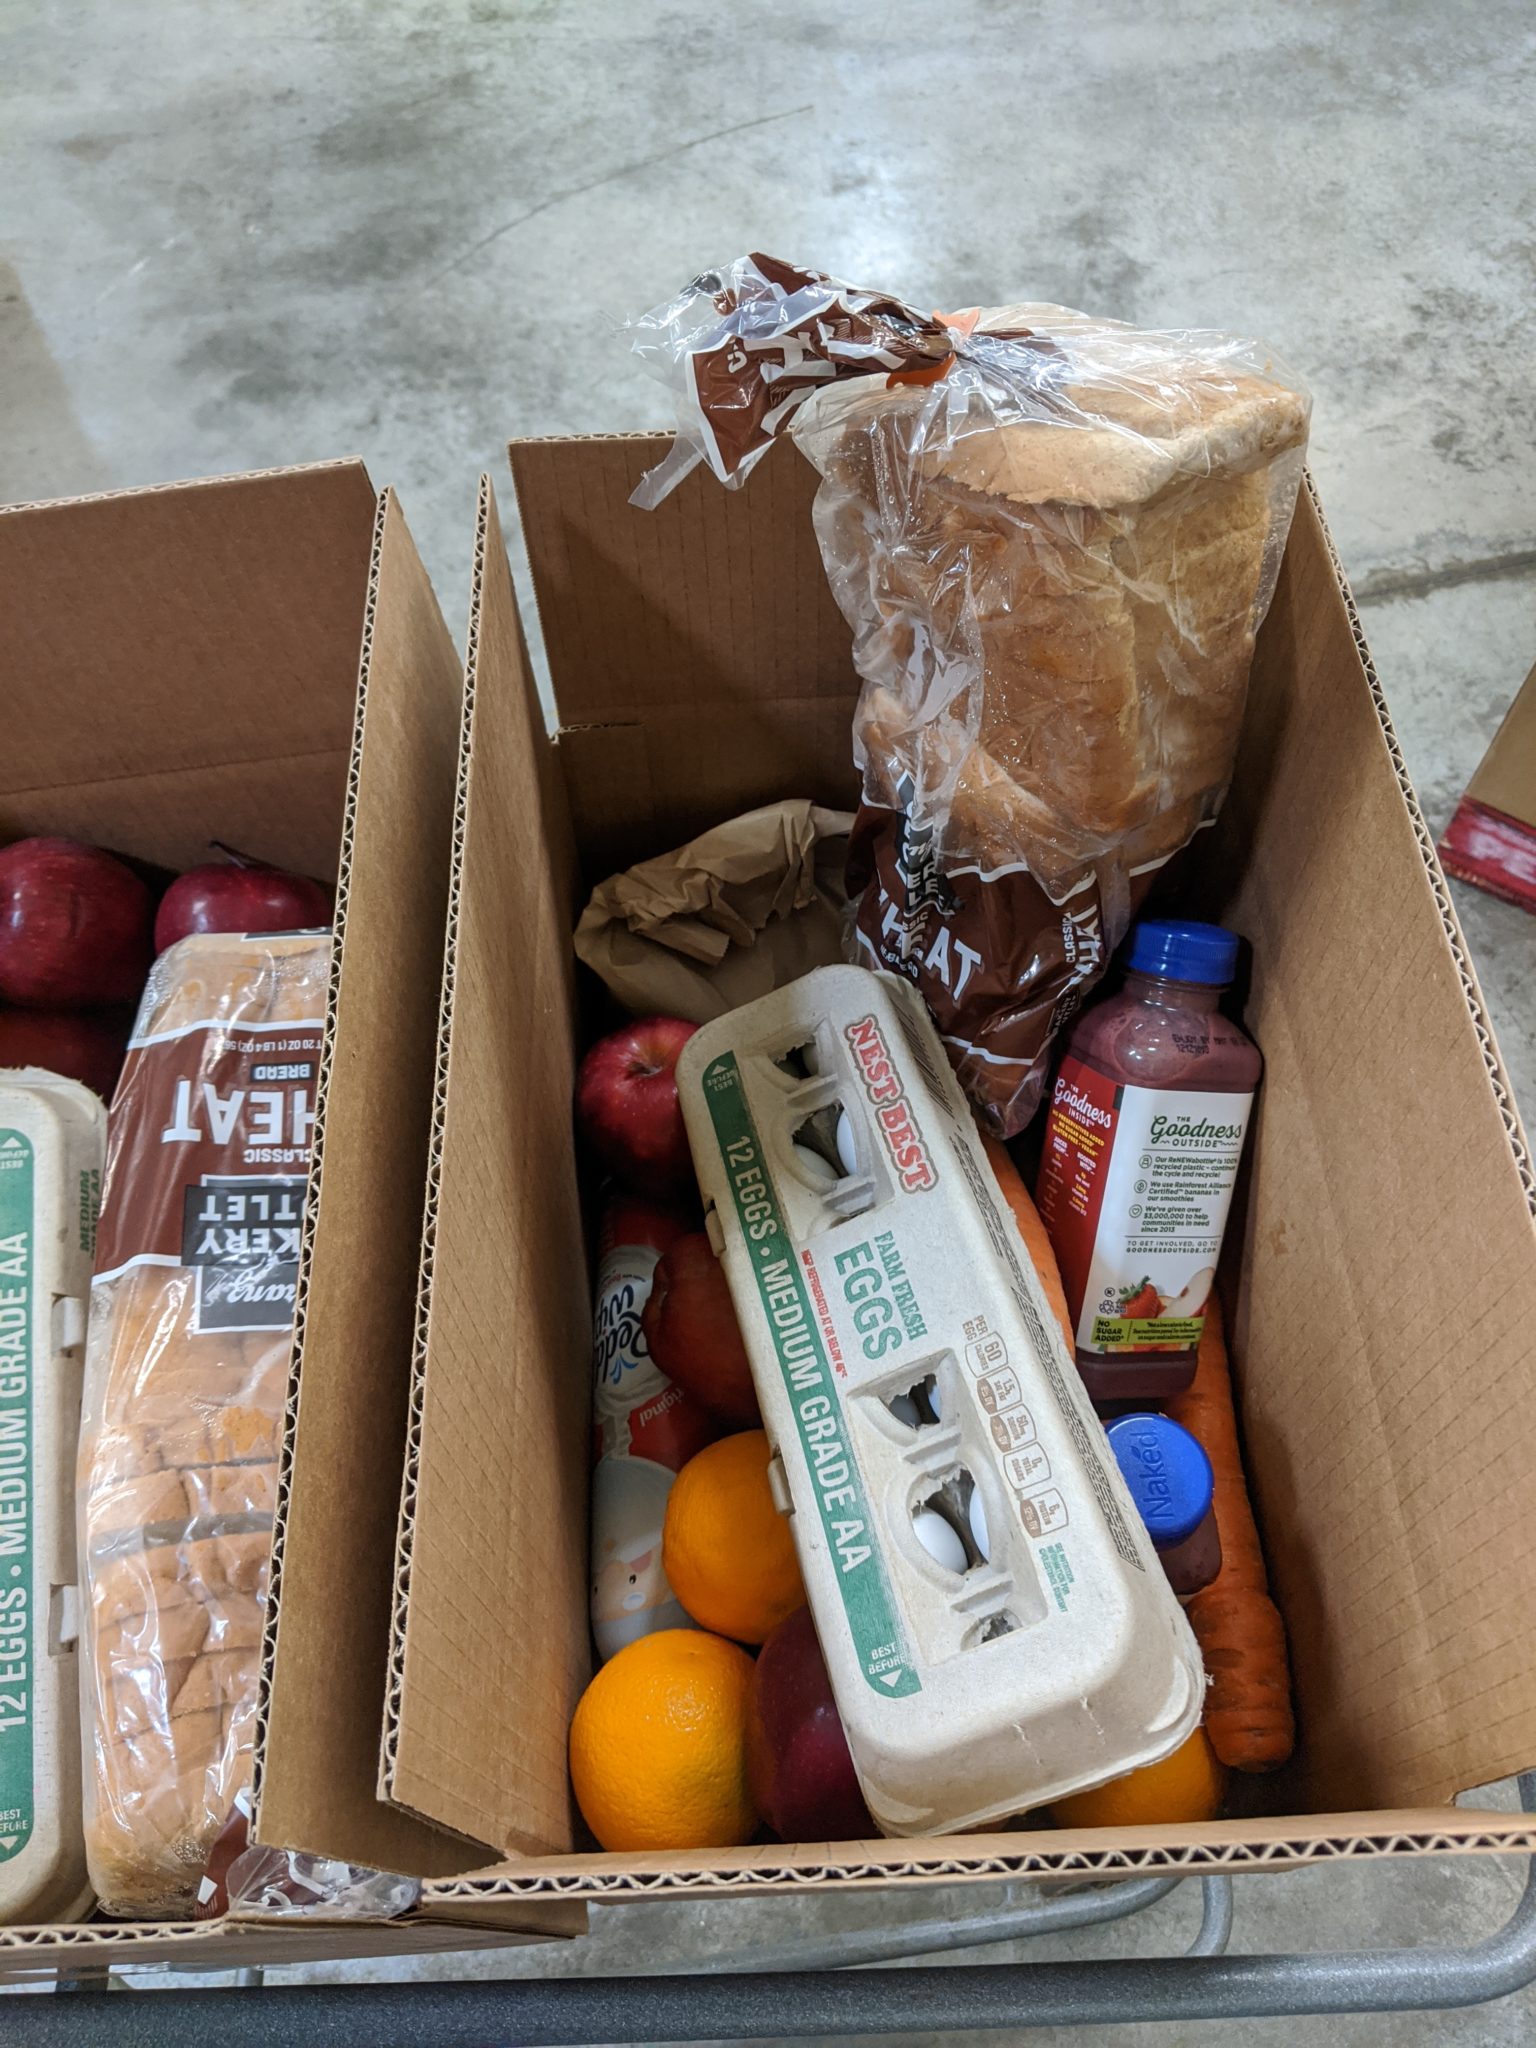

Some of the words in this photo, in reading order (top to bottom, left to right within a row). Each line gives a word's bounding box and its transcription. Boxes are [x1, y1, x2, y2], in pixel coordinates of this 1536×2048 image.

[263, 1040, 277, 1051] LB
[288, 1040, 300, 1050] OZ
[302, 1040, 315, 1049] 20
[254, 1063, 311, 1080] BREAD
[161, 1079, 315, 1144] HEAT
[847, 1014, 901, 1102] NEST
[878, 1099, 937, 1192] BEST
[1054, 1076, 1112, 1129] Goodness
[1150, 1115, 1242, 1145] Goodness
[1176, 1115, 1191, 1123] THE
[243, 1148, 311, 1163] CLASSIC
[726, 1135, 751, 1169] 12
[1153, 1163, 1181, 1171] recycled
[1182, 1163, 1205, 1171] plastic
[1164, 1170, 1181, 1178] cycle
[80, 1169, 90, 1252] MEDIUM
[199, 1194, 308, 1221] TLET
[735, 1165, 778, 1241] EGGS
[1167, 1206, 1186, 1214] given
[1193, 1213, 1209, 1221] help
[0, 1231, 29, 1276] AA
[195, 1227, 302, 1255] KERY
[224, 1260, 299, 1312] ranz
[807, 1267, 829, 1316] REFRIGERATED
[874, 1230, 903, 1281] FARM
[891, 1276, 928, 1342] FRESH
[833, 1240, 903, 1361] EGGS
[761, 1258, 819, 1393] MEDIUM
[821, 1316, 832, 1325] AT
[824, 1326, 835, 1337] OR
[962, 1320, 977, 1341] EGG
[974, 1315, 989, 1335] PER
[1096, 1327, 1122, 1335] SUGAR
[0, 1286, 28, 1398] GRADE
[827, 1336, 842, 1361] BELOW
[984, 1341, 1003, 1362] 60
[975, 1344, 989, 1371] CALORIES
[639, 1386, 684, 1427] riginal
[799, 1398, 858, 1512] GRADE
[1022, 1457, 1034, 1476] TOTAL
[0, 1408, 27, 1556] MEDIUM
[1012, 1458, 1025, 1482] SUGARS
[1130, 1432, 1175, 1520] Naked
[1038, 1500, 1052, 1525] PROTEIN
[831, 1516, 873, 1574] AA
[0, 1586, 27, 1683] EGGS
[871, 1641, 897, 1660] BEST
[0, 1691, 27, 1732] 12
